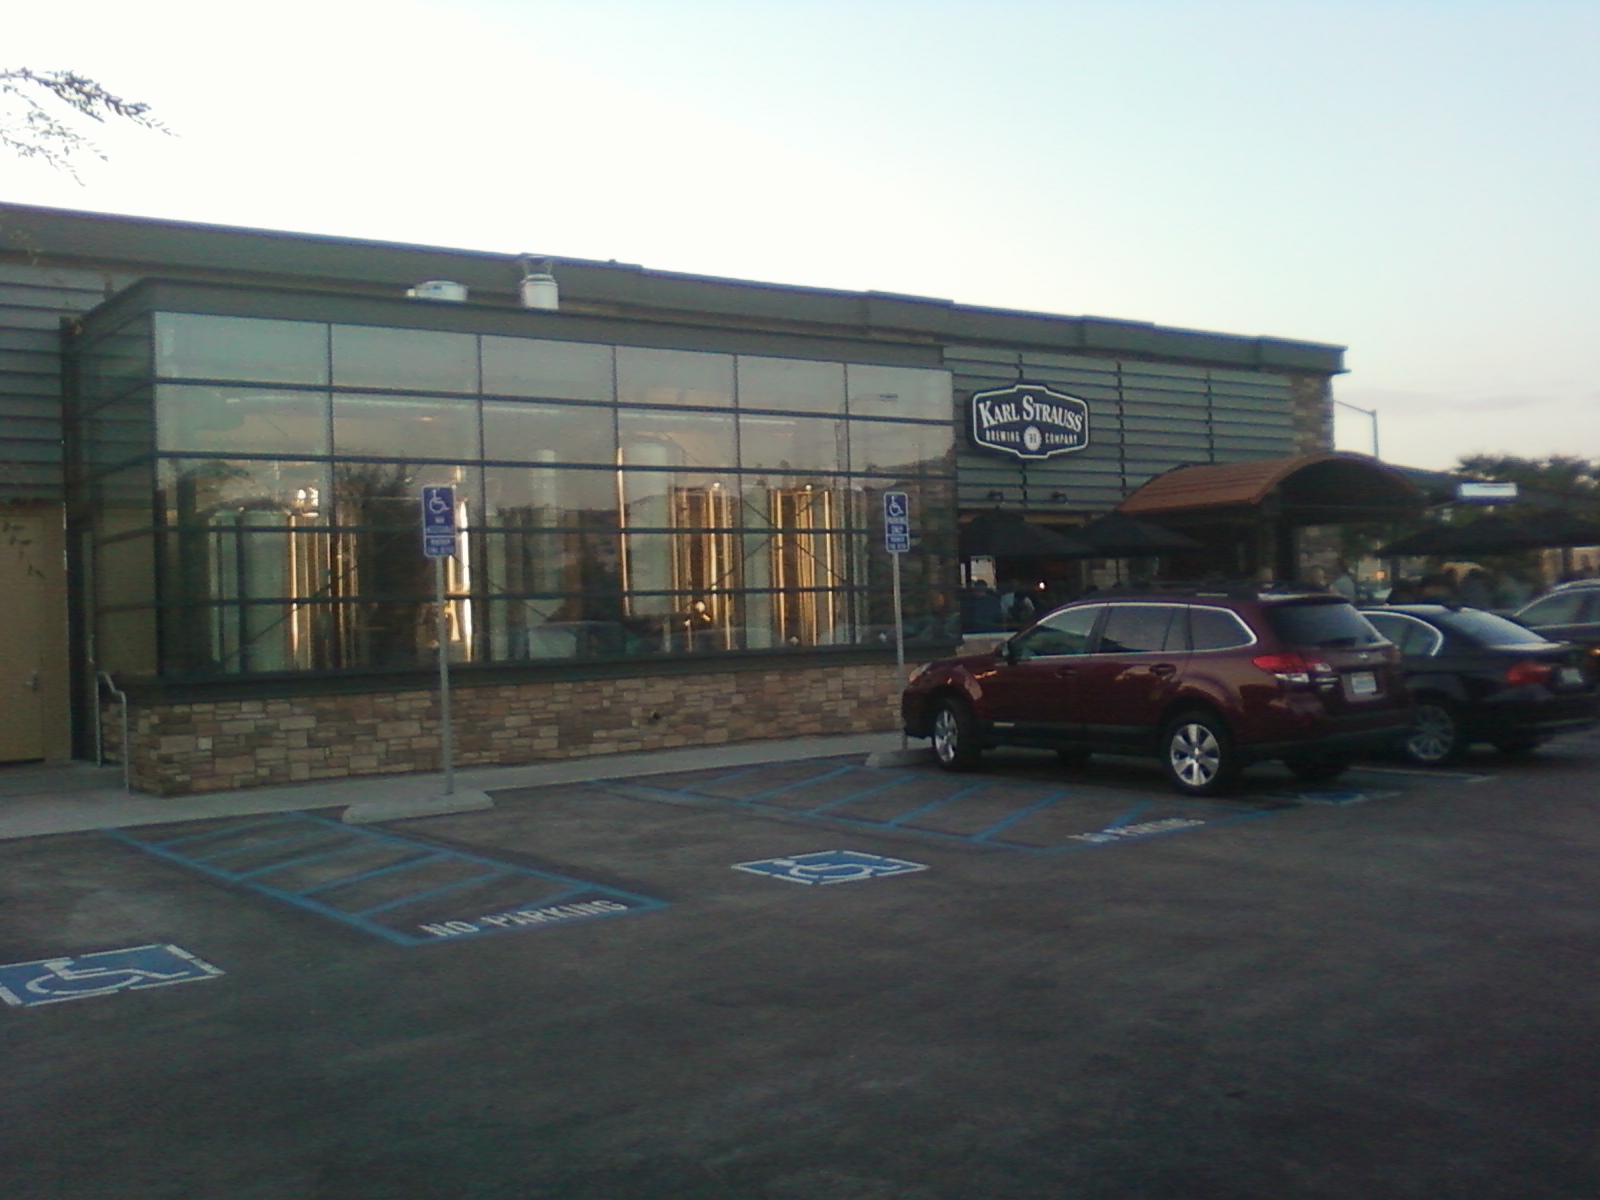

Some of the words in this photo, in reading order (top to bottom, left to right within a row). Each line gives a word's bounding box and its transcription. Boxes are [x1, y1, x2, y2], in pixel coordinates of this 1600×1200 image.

[979, 401, 1020, 428] KARL
[1045, 433, 1078, 445] COMPANY
[418, 921, 480, 937] NO
[480, 900, 628, 928] PARKING
